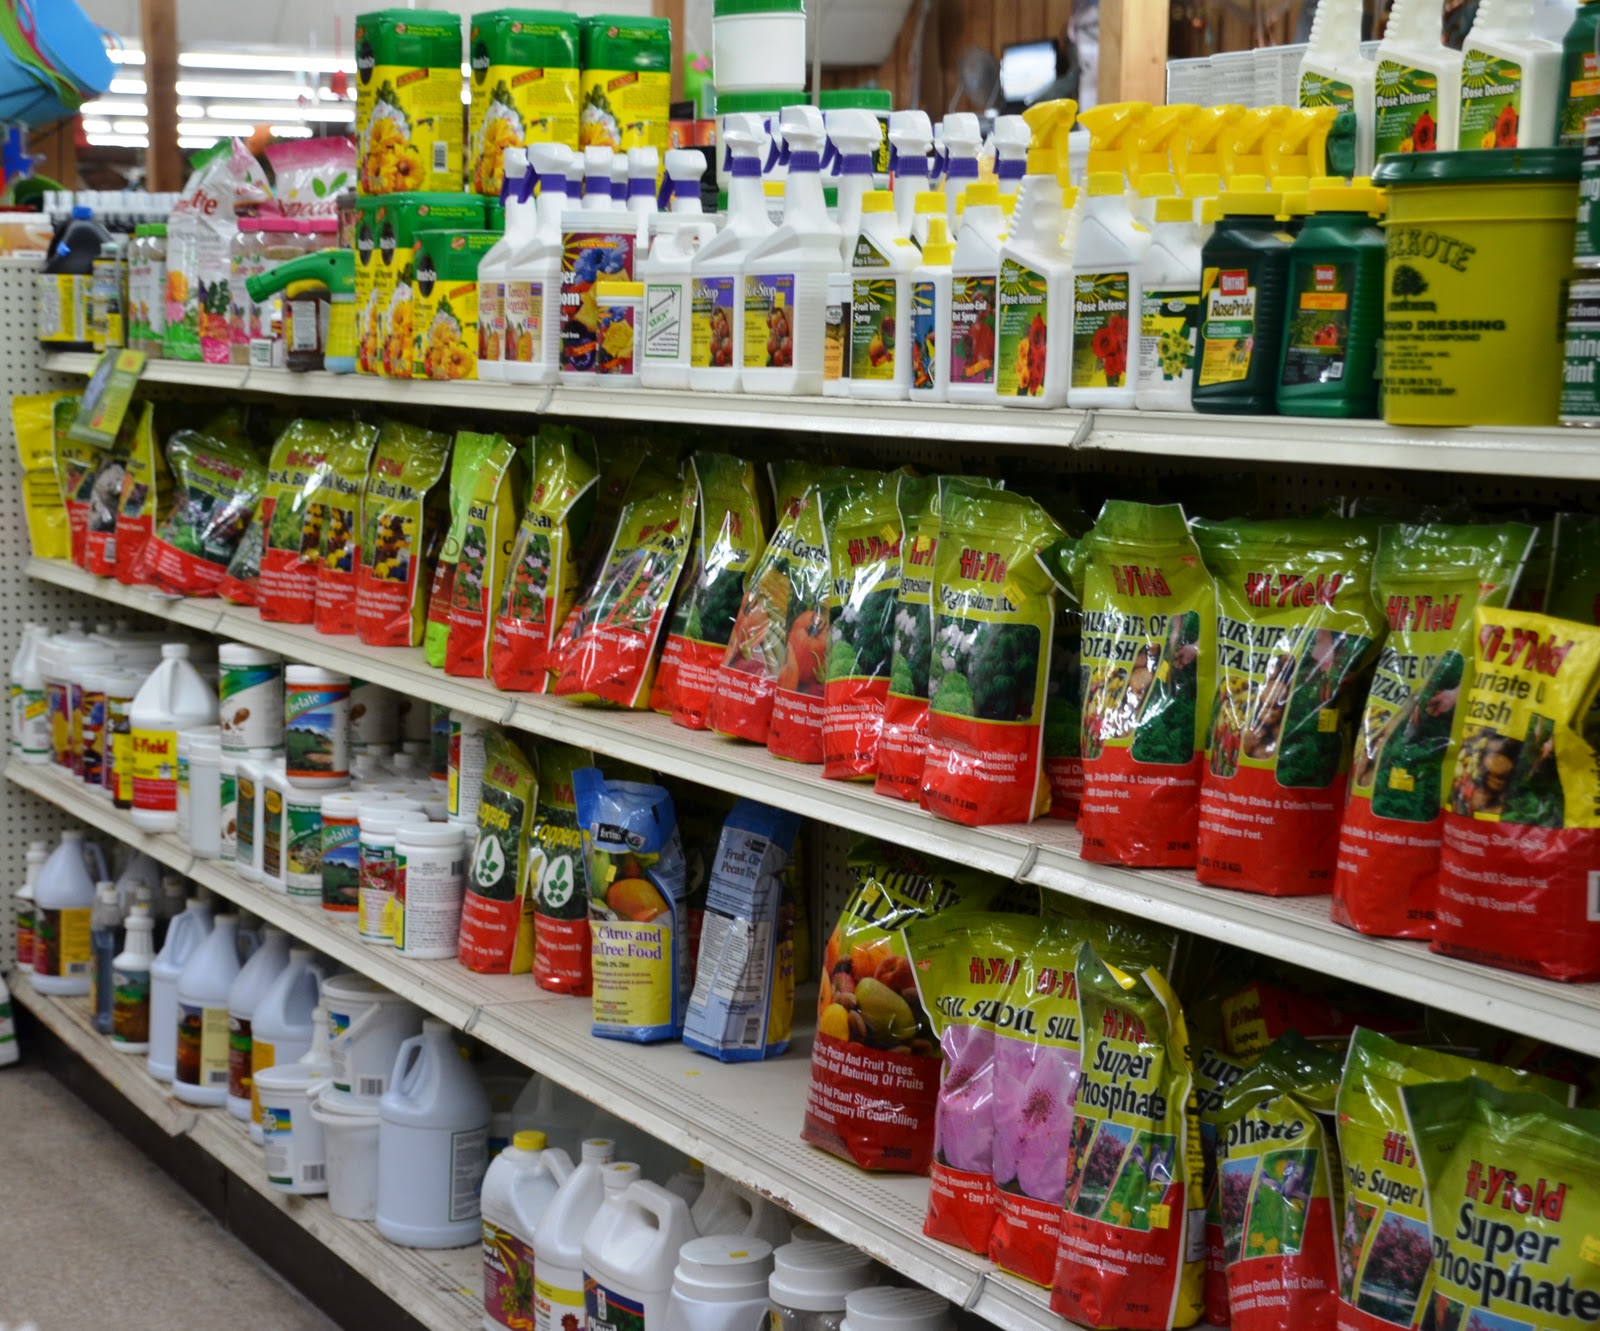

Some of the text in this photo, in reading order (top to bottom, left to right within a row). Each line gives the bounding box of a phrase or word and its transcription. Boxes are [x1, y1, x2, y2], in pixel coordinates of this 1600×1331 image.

[1377, 92, 1431, 108] Rose Defense
[1462, 83, 1515, 99] Rose Defense
[560, 271, 576, 285] per
[1222, 275, 1246, 291] ORTHO
[854, 302, 870, 312] Fruit
[1000, 293, 1043, 305] Rose Defense
[1076, 300, 1127, 313] Rose Defense
[1211, 299, 1253, 317] RosePride
[854, 313, 871, 325] Spray
[1417, 319, 1507, 331] DRESSING
[901, 578, 933, 595] gnesium
[1244, 572, 1342, 608] Hi-Yield
[941, 584, 994, 612] agnsium
[1386, 594, 1462, 632] Hi-Yield
[1149, 615, 1168, 637] OF
[1473, 669, 1531, 700] uriate
[288, 692, 320, 714] helate
[1467, 696, 1512, 726] tash
[477, 802, 511, 830] opperas
[323, 826, 354, 845] helate
[721, 861, 745, 876] Pecan
[598, 926, 662, 943] Citrus and
[600, 943, 662, 960] Tree Food
[996, 1004, 1038, 1035] OIL
[827, 1045, 916, 1077] Pecan And Fruit Trees.
[1093, 1040, 1153, 1084] Super
[841, 1065, 879, 1086] Maturing
[882, 1074, 894, 1086] Of
[896, 1076, 925, 1091] Fruits
[833, 1087, 852, 1104] Plant
[1079, 1071, 1167, 1121] Phosphate
[823, 1096, 919, 1131] Necessary In Controlling
[1220, 1115, 1305, 1159] phate
[949, 1177, 992, 1191] Ornamentals &
[1368, 1169, 1417, 1206] Super
[968, 1192, 984, 1206] Easy
[1021, 1205, 1060, 1223] Ornamentals
[1456, 1202, 1561, 1265] Super
[1100, 1244, 1125, 1260] Growth
[1126, 1250, 1142, 1264] And
[1143, 1253, 1166, 1266] Color.
[1101, 1258, 1129, 1276] Blooms.
[1253, 1278, 1281, 1293] Growth
[1282, 1277, 1300, 1289] And
[1301, 1276, 1327, 1289] Color.
[1433, 1234, 1600, 1322] Phosphate
[1256, 1295, 1291, 1308] Blooms.
